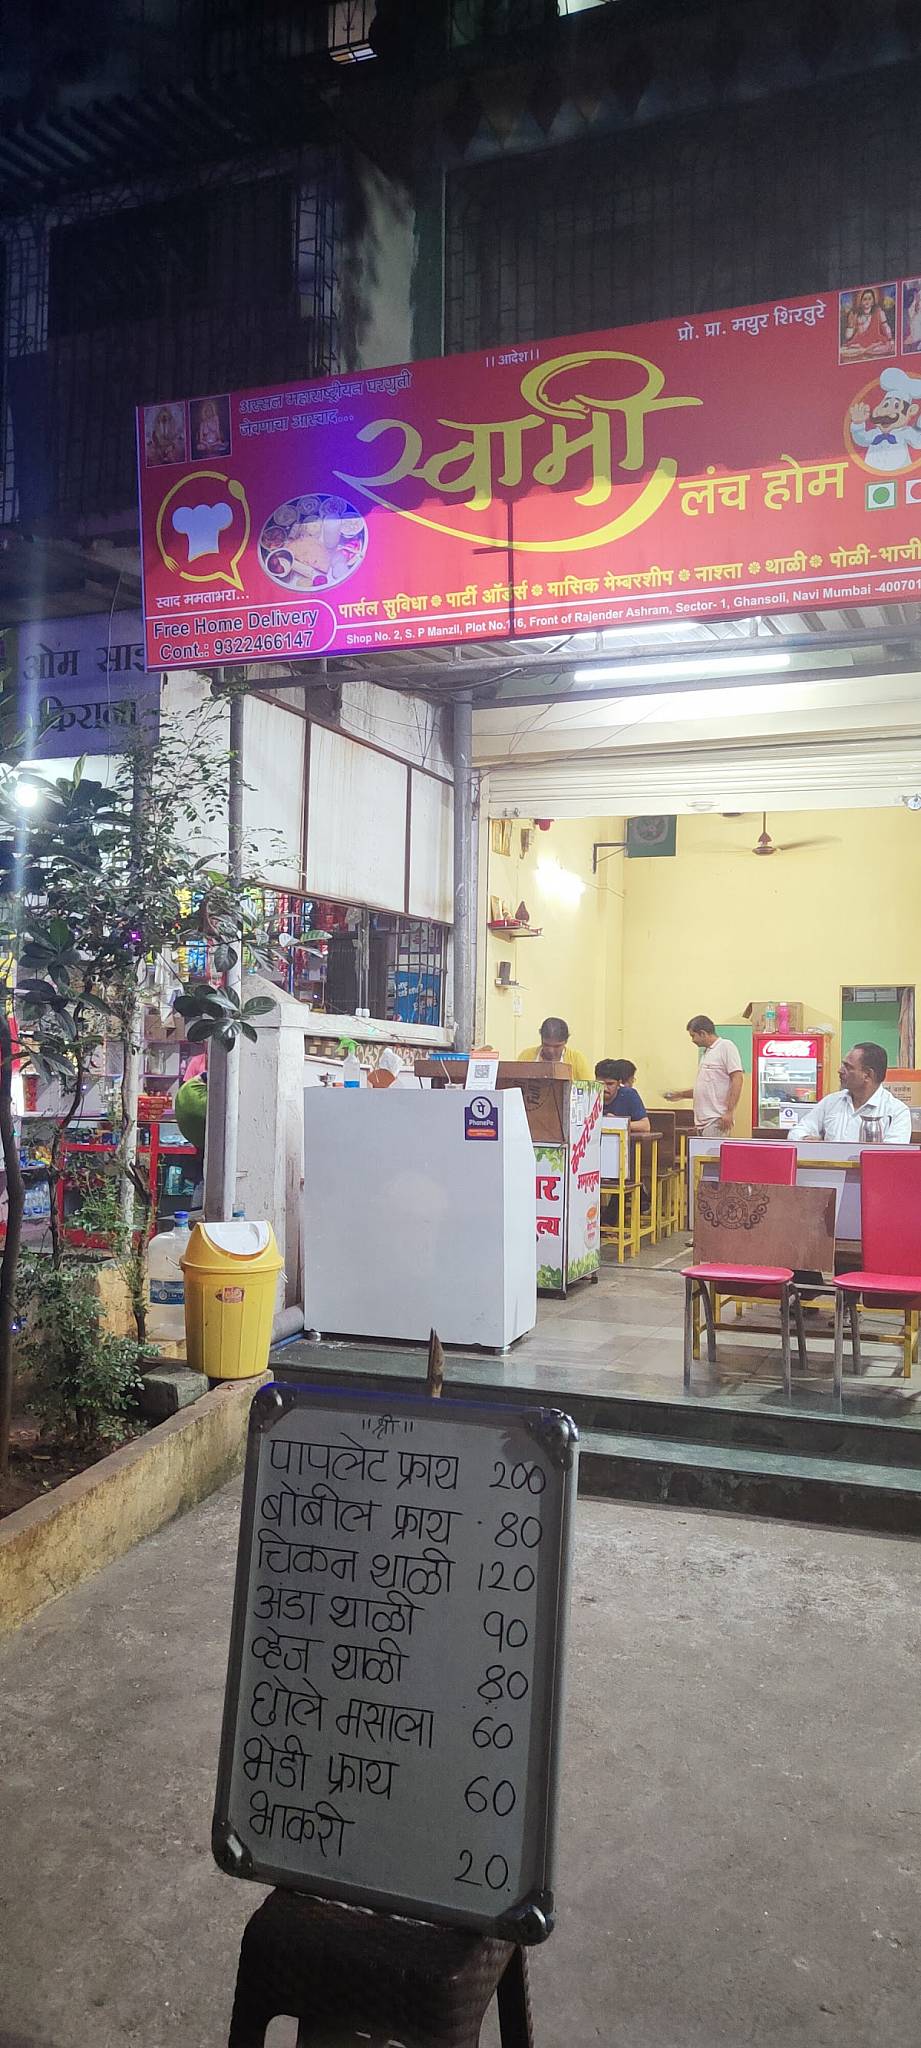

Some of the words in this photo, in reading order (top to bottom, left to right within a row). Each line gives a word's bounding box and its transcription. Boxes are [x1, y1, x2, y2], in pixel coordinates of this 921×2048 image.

[677, 322, 699, 341] प्रो.
[704, 322, 727, 338] प्रा.
[731, 313, 769, 336] मयुर
[773, 300, 827, 326] शिरतुरे
[332, 350, 703, 552] स्वामी
[678, 465, 750, 516] लंच
[762, 453, 848, 511] होम
[156, 595, 182, 609] स्वाद
[338, 597, 378, 618] पार्सल
[382, 593, 428, 619] सुविधा
[446, 584, 478, 608] पार्टी
[547, 575, 600, 597] मासिक
[603, 565, 674, 592] मेम्बरशीप
[694, 561, 743, 583] नाश्ता
[764, 549, 807, 575] थाळी
[346, 634, 372, 645] Shop
[374, 631, 391, 642] No.
[394, 629, 403, 641] 2,
[405, 629, 416, 639] S.
[418, 627, 426, 638] P
[427, 625, 463, 637] Manzil,
[465, 621, 486, 633] Plot
[529, 615, 559, 627] Front
[561, 613, 572, 625] of
[574, 609, 624, 624] Rajender
[626, 604, 673, 619] Ashram,
[733, 592, 790, 609] Ghansoli,
[792, 589, 819, 602] Navi
[823, 583, 871, 599] Mumbai
[154, 622, 189, 639] Free
[195, 617, 243, 636] Home
[247, 609, 318, 630] Delivery
[214, 630, 313, 655] 9322466147
[269, 1432, 389, 1482] पापलेट
[397, 1451, 460, 1490] फ्राय
[489, 1461, 547, 1495] 200
[391, 1505, 463, 1545] फ्राय
[495, 1511, 544, 1549] 80
[258, 1528, 359, 1582] चिकन
[370, 1547, 456, 1596] थाळी
[477, 1561, 536, 1593] 120
[329, 1589, 425, 1635] थाळी
[483, 1610, 529, 1654] 90
[251, 1626, 325, 1674] व्हेज
[332, 1637, 410, 1684] थाळी
[477, 1664, 529, 1700] 80
[251, 1674, 328, 1732] छोले
[335, 1698, 434, 1749] मसाला
[472, 1716, 514, 1749] 60
[328, 1752, 400, 1800] फ्राय
[464, 1775, 516, 1817] 60
[249, 1790, 356, 1858] भाकरी
